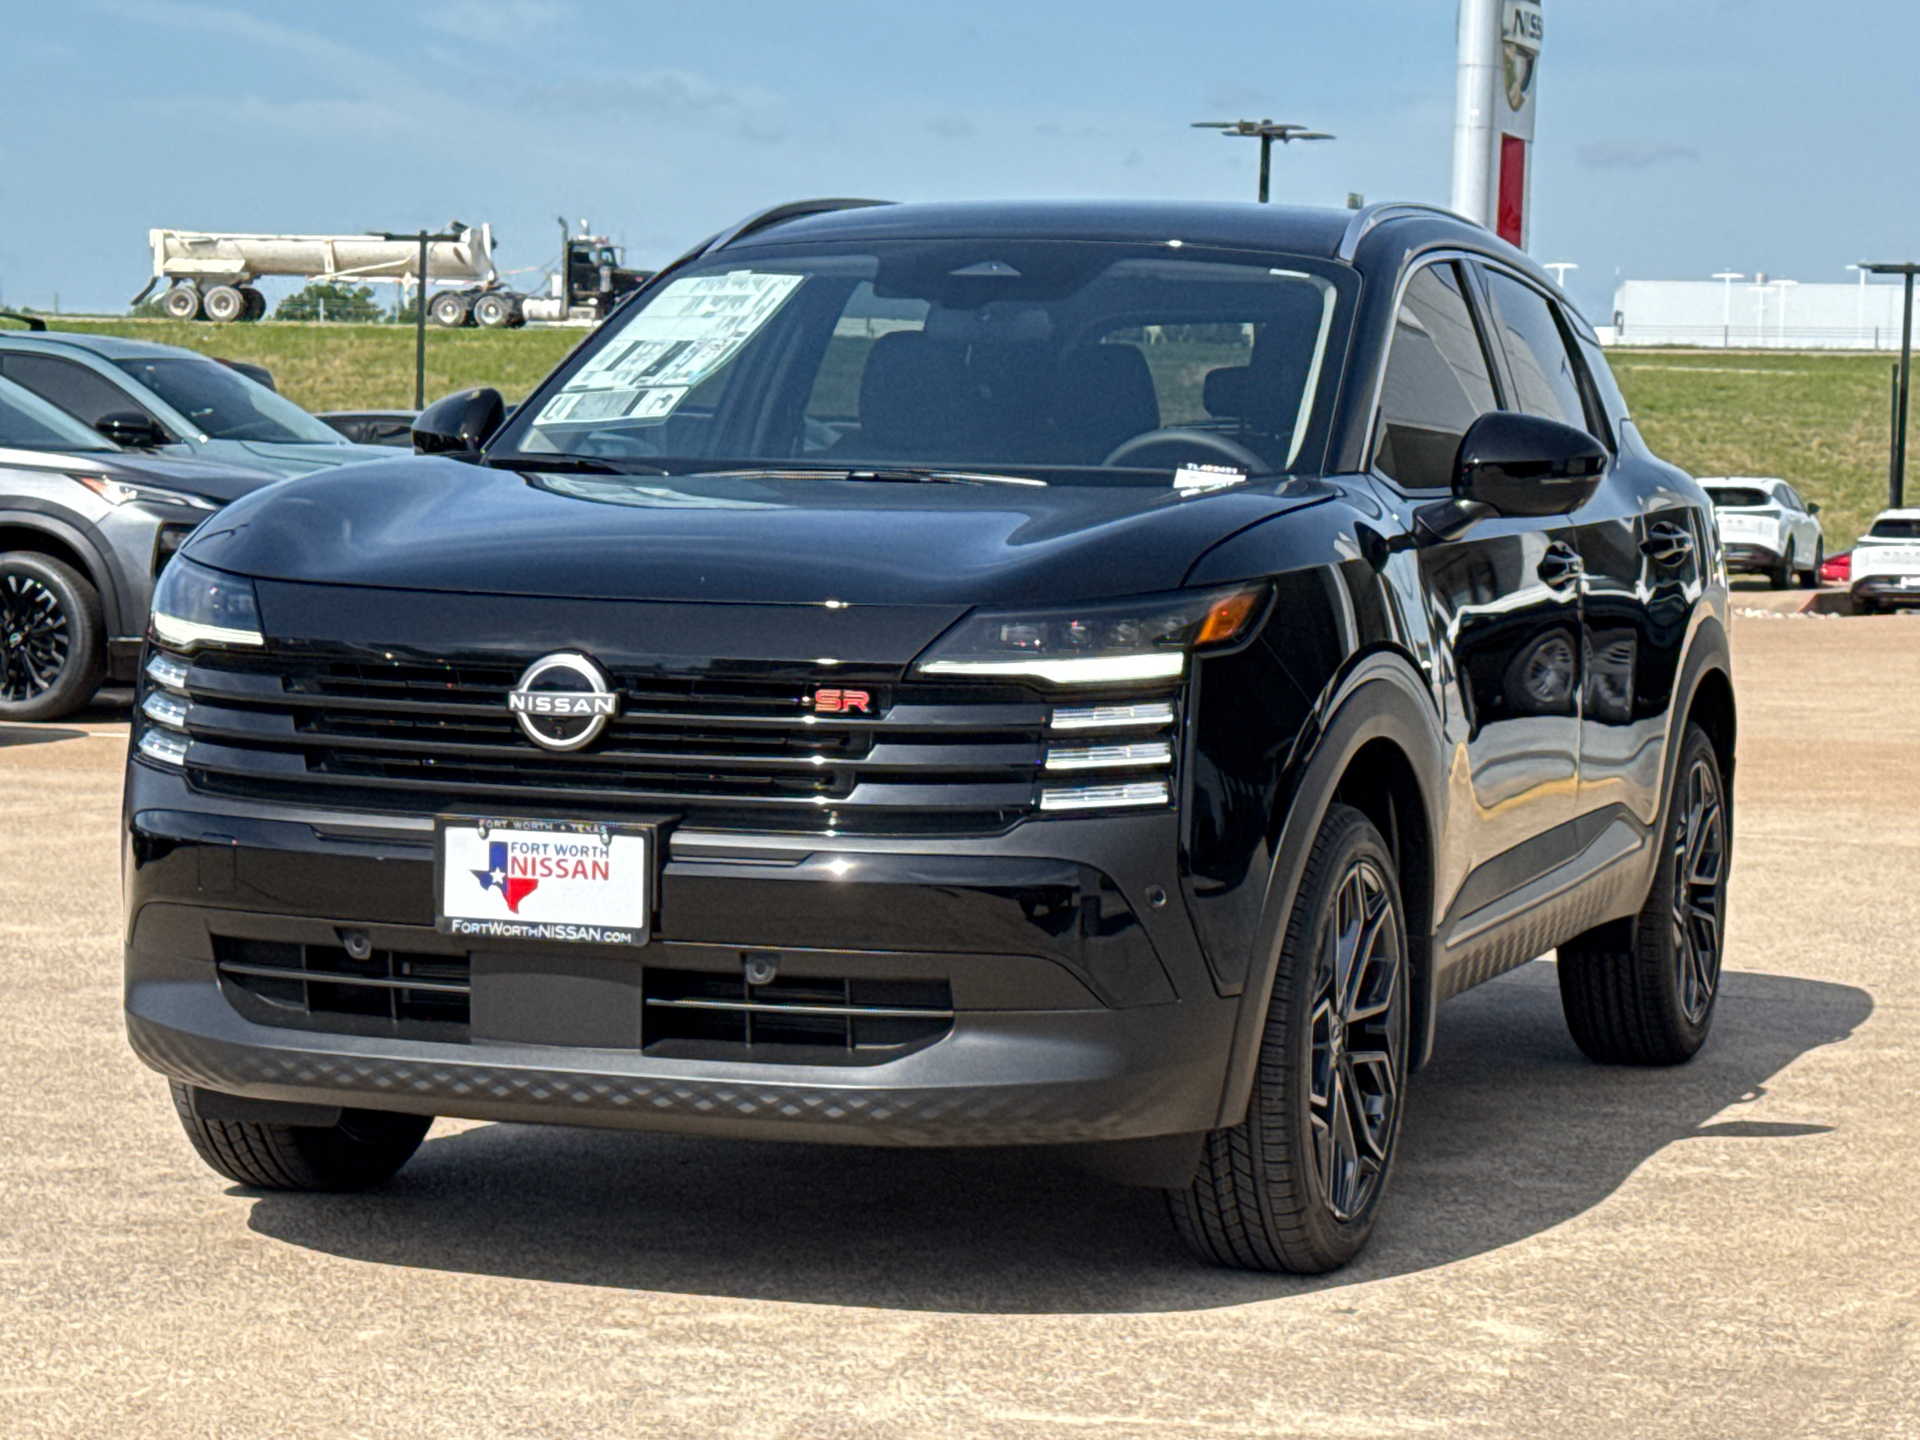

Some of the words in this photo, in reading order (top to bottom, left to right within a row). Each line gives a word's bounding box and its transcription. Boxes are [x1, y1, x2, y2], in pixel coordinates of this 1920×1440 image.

[509, 693, 615, 715] NISSAN
[814, 688, 870, 713] SR
[478, 818, 508, 829] FORT
[513, 820, 553, 831] WORTH
[569, 823, 607, 835] TEXAS
[510, 841, 550, 856] FORT
[553, 843, 609, 859] WORTH
[510, 855, 609, 881] NISSAN
